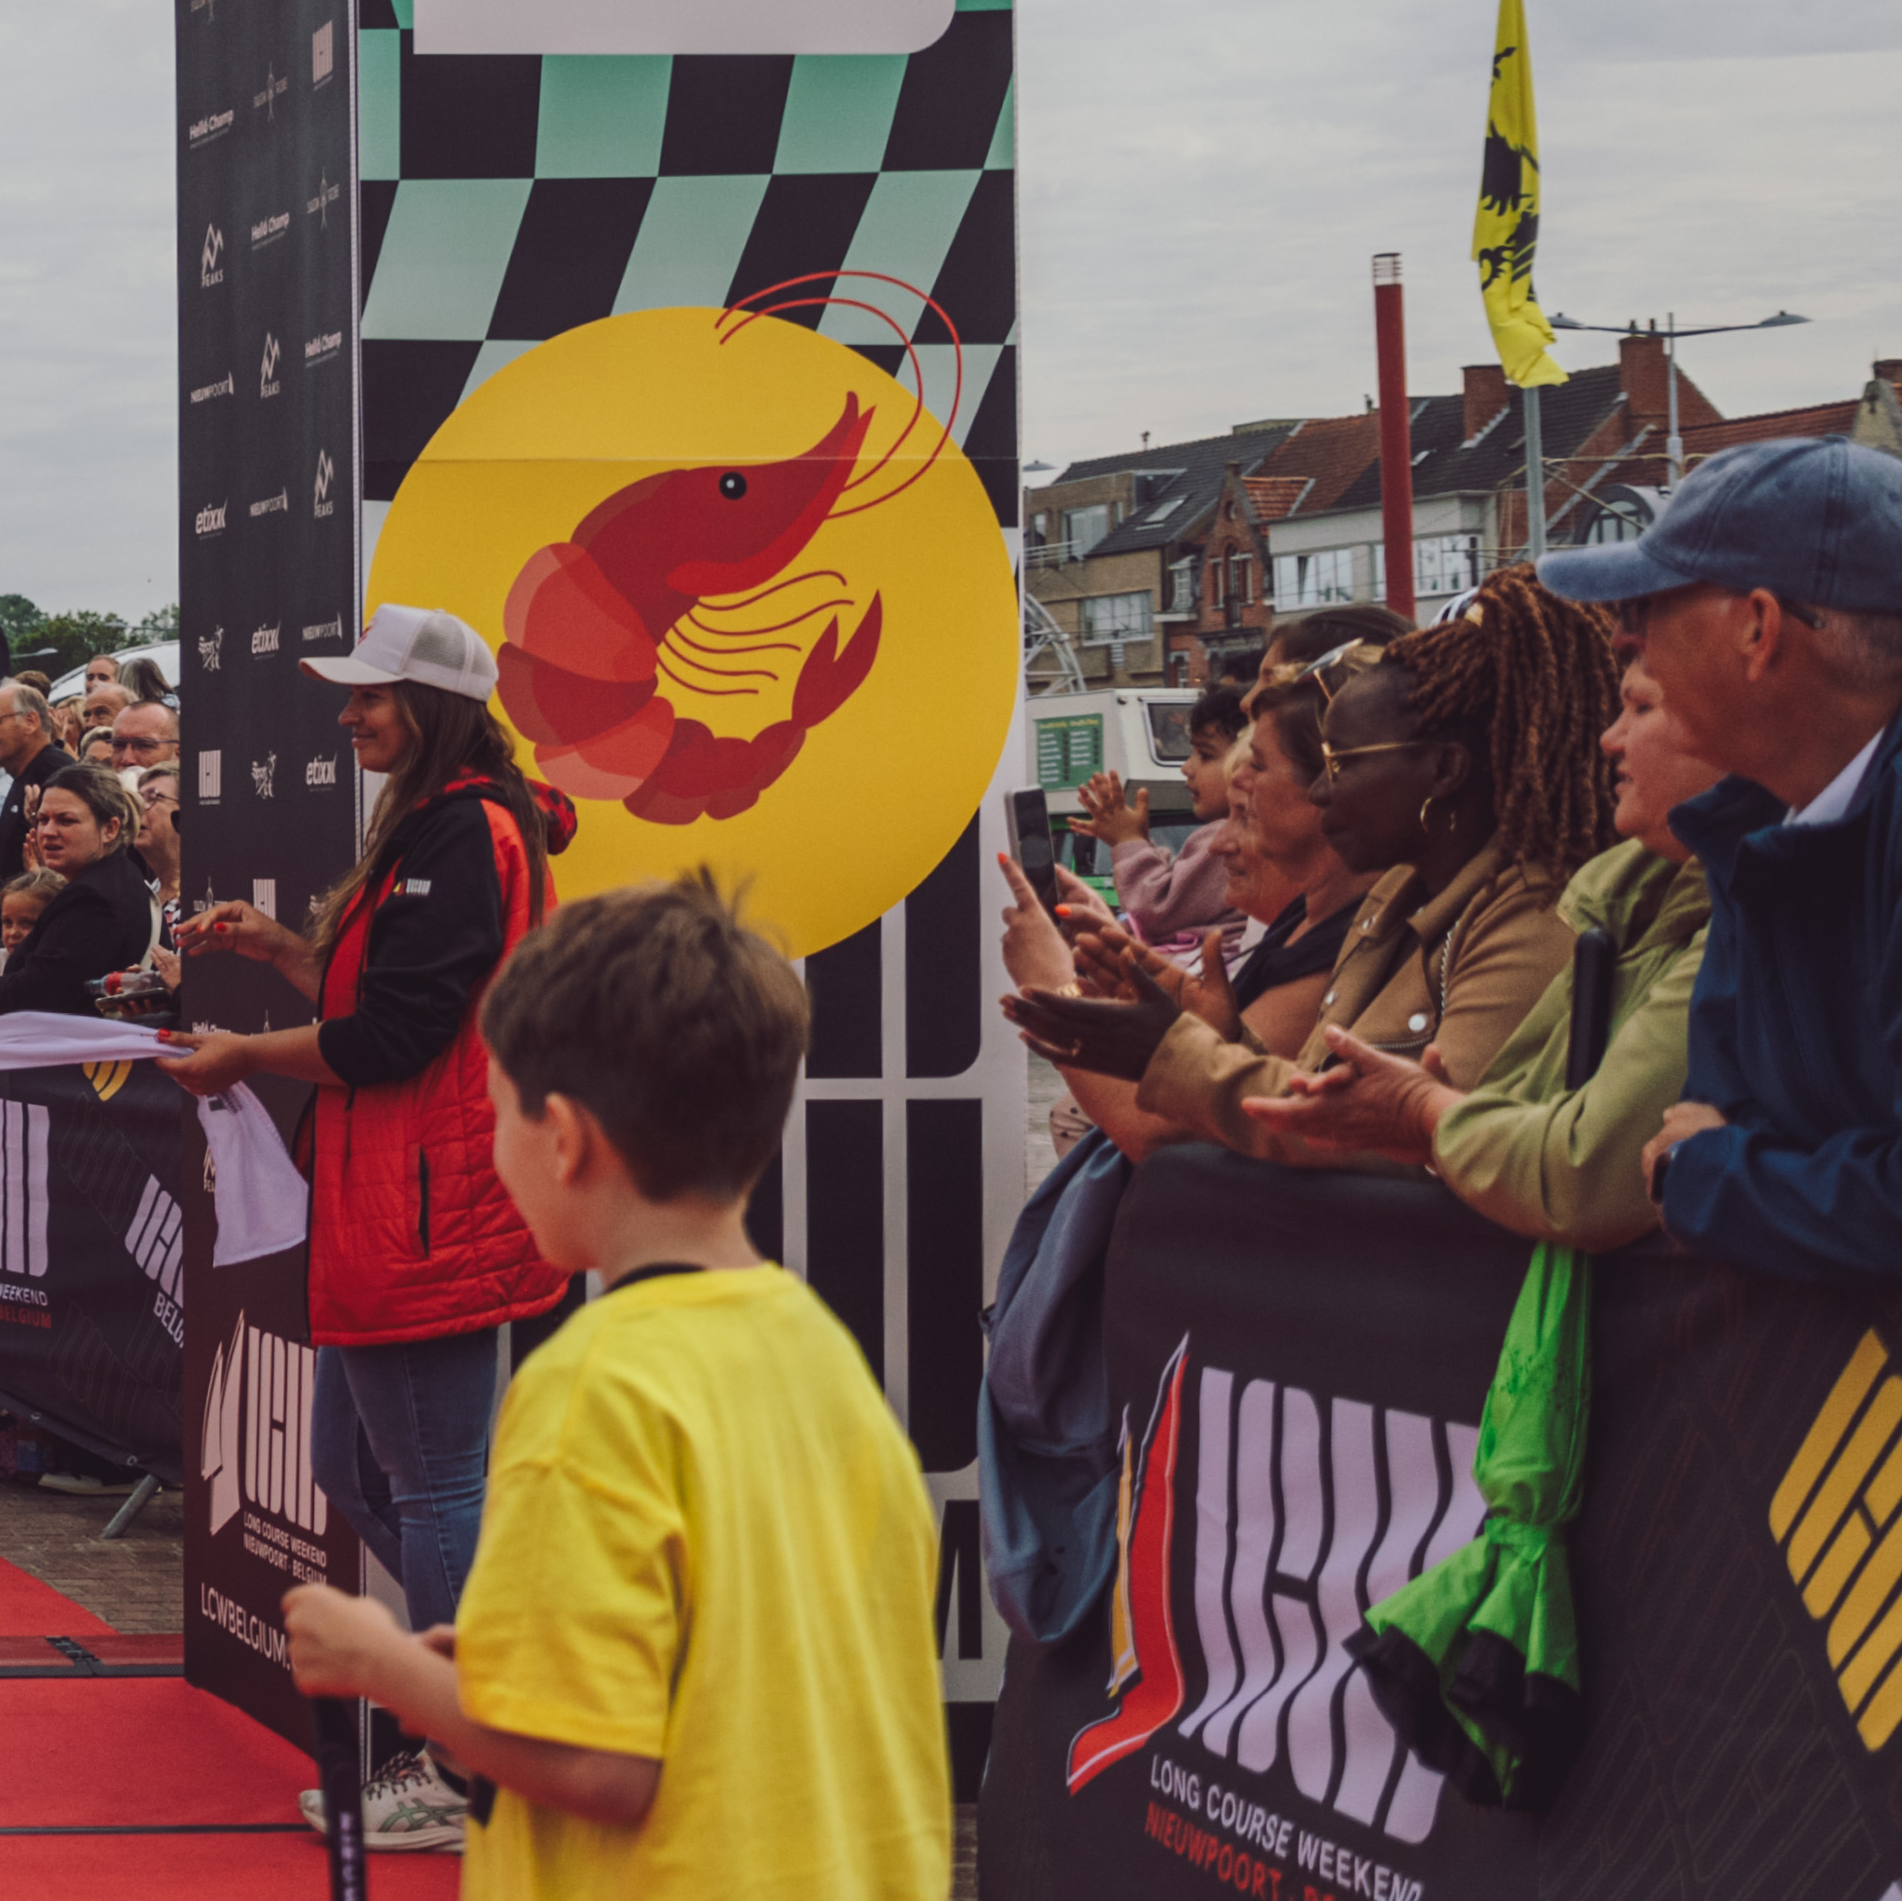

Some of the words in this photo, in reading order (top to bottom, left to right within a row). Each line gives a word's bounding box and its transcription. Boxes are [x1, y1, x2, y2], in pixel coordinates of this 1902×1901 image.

[201, 269, 224, 288] PEAKS
[260, 380, 280, 399] PEAKS
[314, 500, 333, 519] PEAKS
[243, 1510, 261, 1535] LONG
[262, 1519, 290, 1552] COURSE
[290, 1531, 328, 1569] WEEKEND
[243, 1531, 290, 1575] NIEUWPOORT
[201, 1581, 291, 1672] LCWBELGIUM.
[1150, 1753, 1203, 1810] LONG
[1205, 1782, 1294, 1860] COURSE
[1144, 1800, 1283, 1901] NIEUWPOORT
